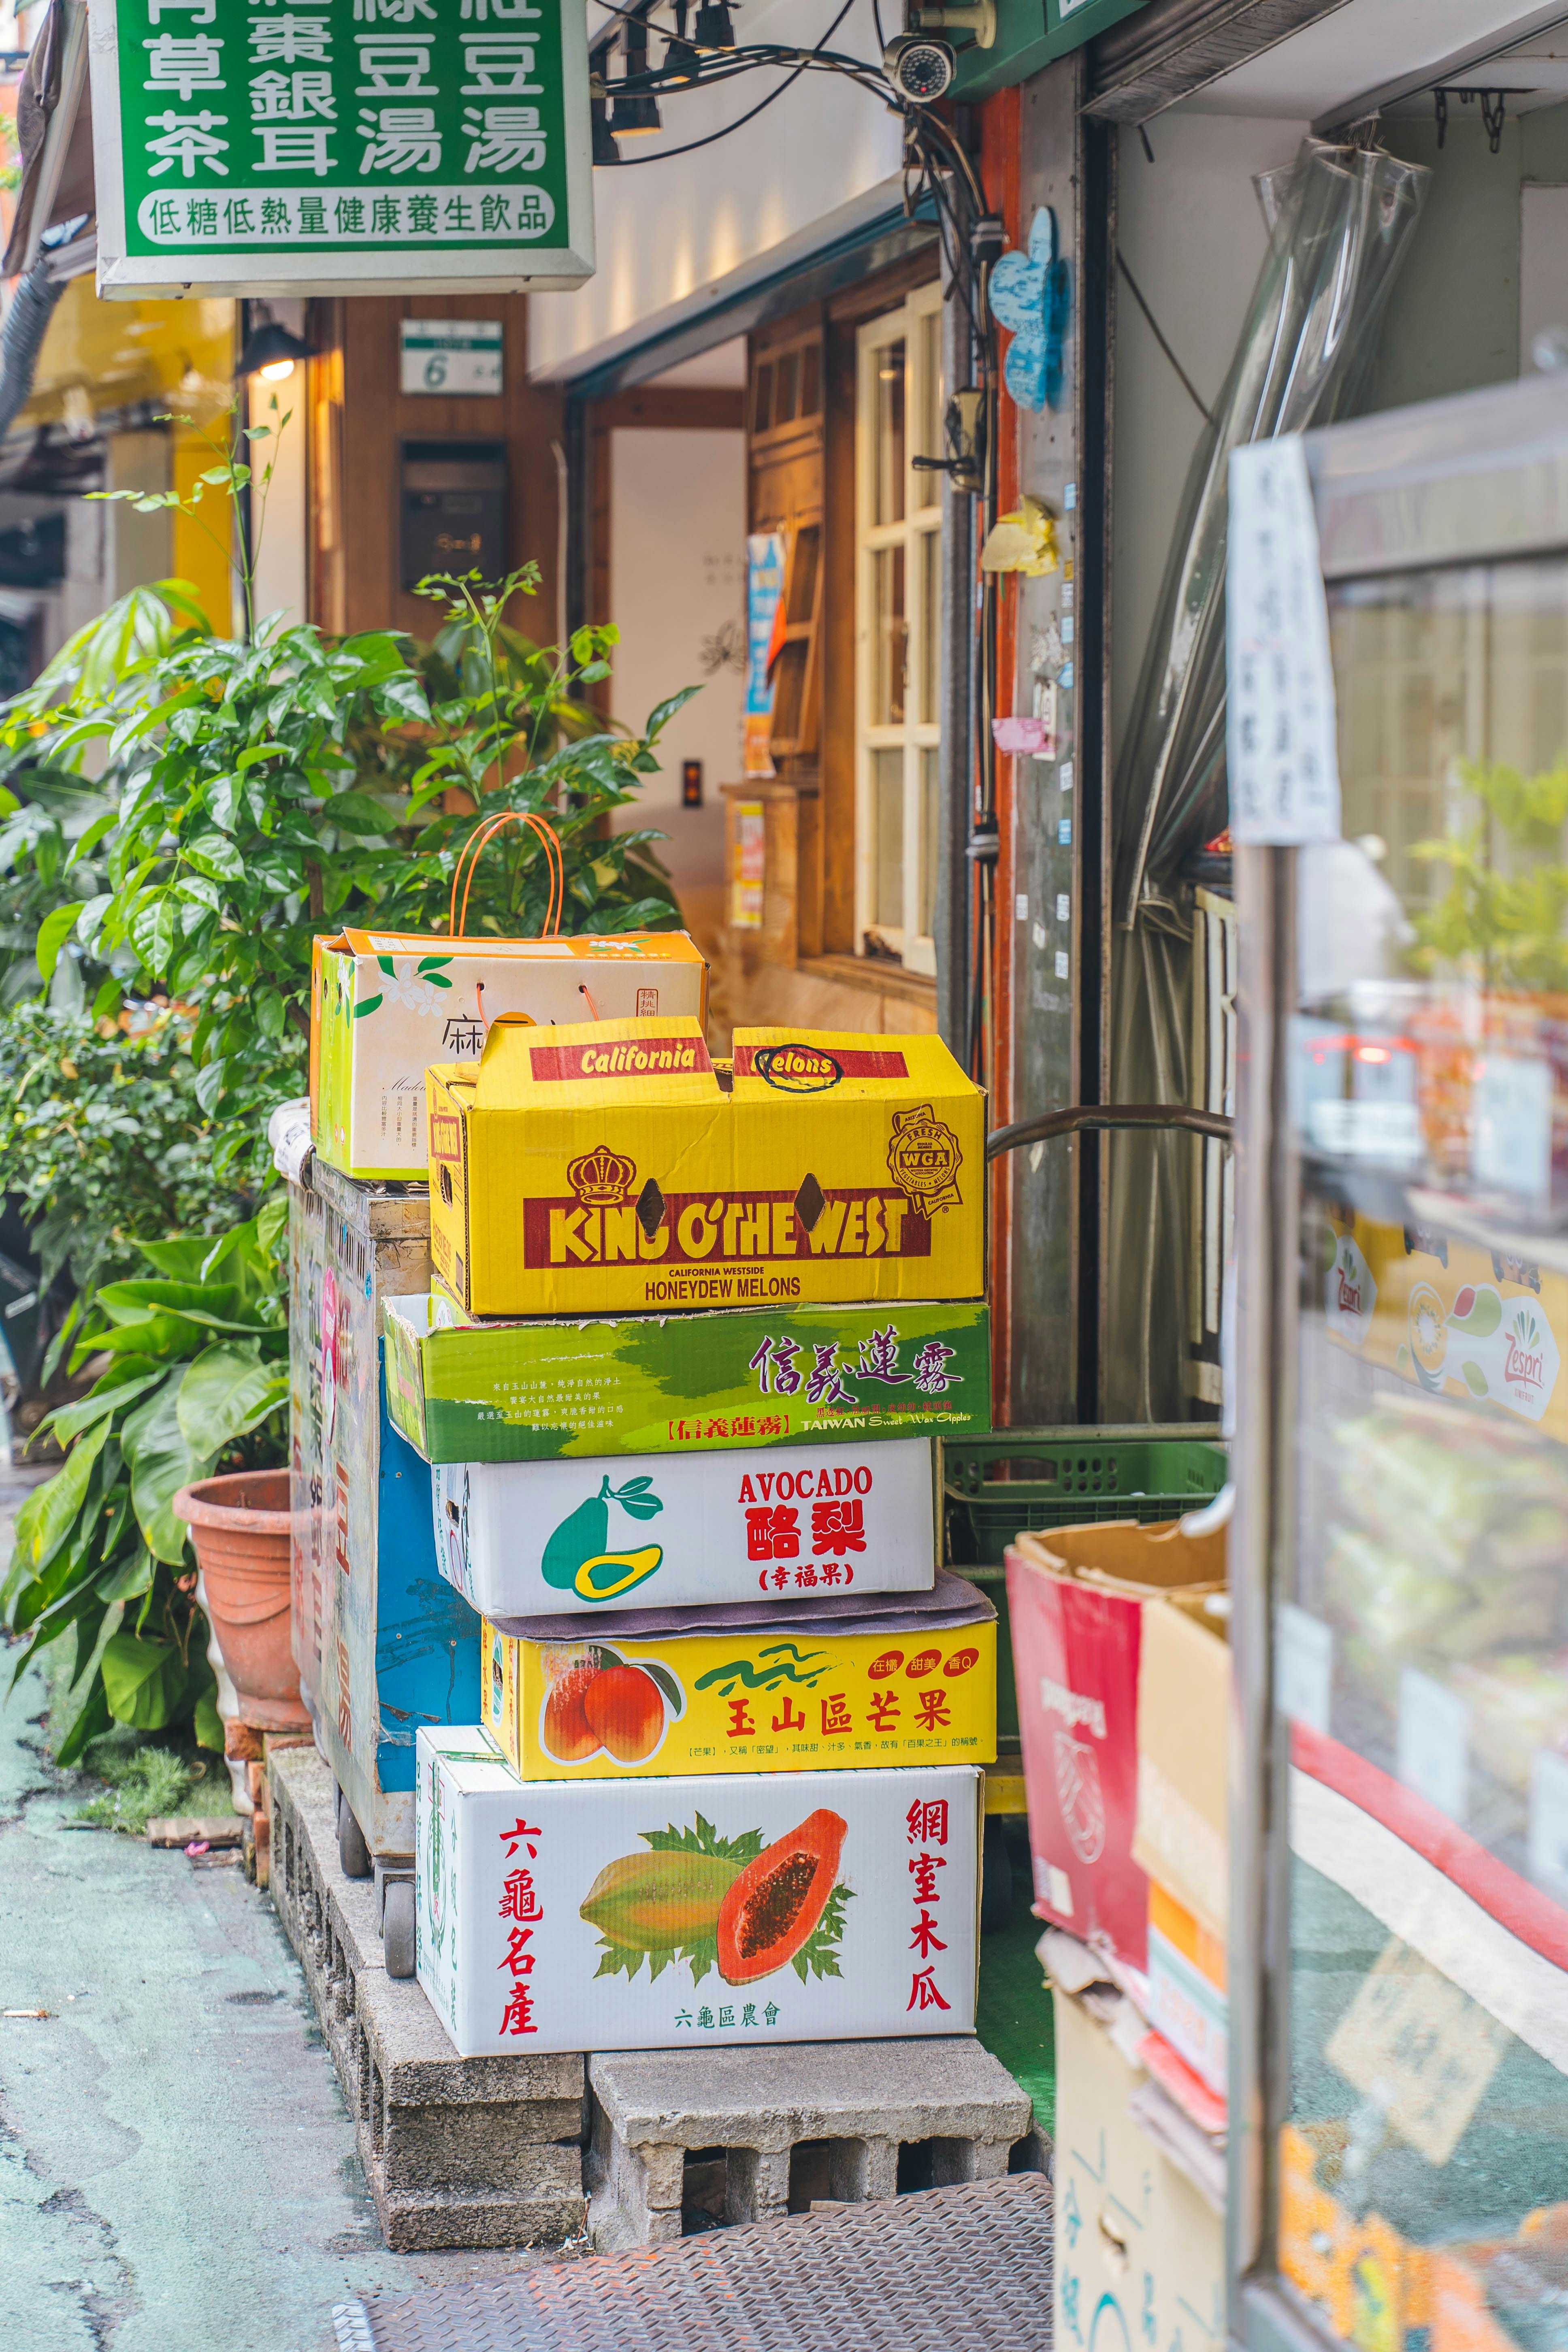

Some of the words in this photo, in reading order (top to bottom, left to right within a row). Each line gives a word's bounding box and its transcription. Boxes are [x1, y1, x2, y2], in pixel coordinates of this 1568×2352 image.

[247, 0, 339, 177] 棗銀耳
[149, 193, 547, 237] 低糖低熱量健康養生飲品
[582, 1043, 695, 1073] California
[905, 1112, 926, 1122] ARIZONA
[907, 1128, 942, 1141] FRESH
[902, 1152, 948, 1166] WGA
[900, 1168, 927, 1187] VEGETABLES
[933, 1167, 950, 1185] MELONS
[928, 1193, 954, 1205] CALIFORNIA
[669, 1268, 720, 1277] CALIFORNIA
[723, 1267, 765, 1275] WESTSIDE
[646, 1279, 733, 1301] HONEYDEW
[737, 1277, 801, 1297] MELONS
[749, 1323, 963, 1404] 信義蓮霧
[1504, 1332, 1543, 1390] Zespri
[493, 1377, 621, 1391] 來自玉山山麓，純淨自然的淨土
[510, 1392, 601, 1405] 饗宴大自然最甜美的果
[531, 1419, 614, 1432] 難以忘懷的絕佳滋味
[669, 1415, 789, 1440] 【信義蓮霧】
[801, 1417, 866, 1431] TAIWAN
[869, 1416, 903, 1426] Sweet
[908, 1414, 933, 1423] Wax
[937, 1412, 971, 1424] Apples
[738, 1465, 873, 1504] AVOCADO
[745, 1498, 868, 1562] 酪梨
[758, 1563, 854, 1591] (幸福果)
[911, 1657, 936, 1671] 甜美
[948, 1656, 971, 1670] 香Q
[726, 1689, 952, 1738] 玉山區芒果
[905, 1799, 952, 2011] 網室木瓜
[496, 1818, 544, 2036] 六龜名產
[674, 2001, 782, 2028] 六龜區農會
